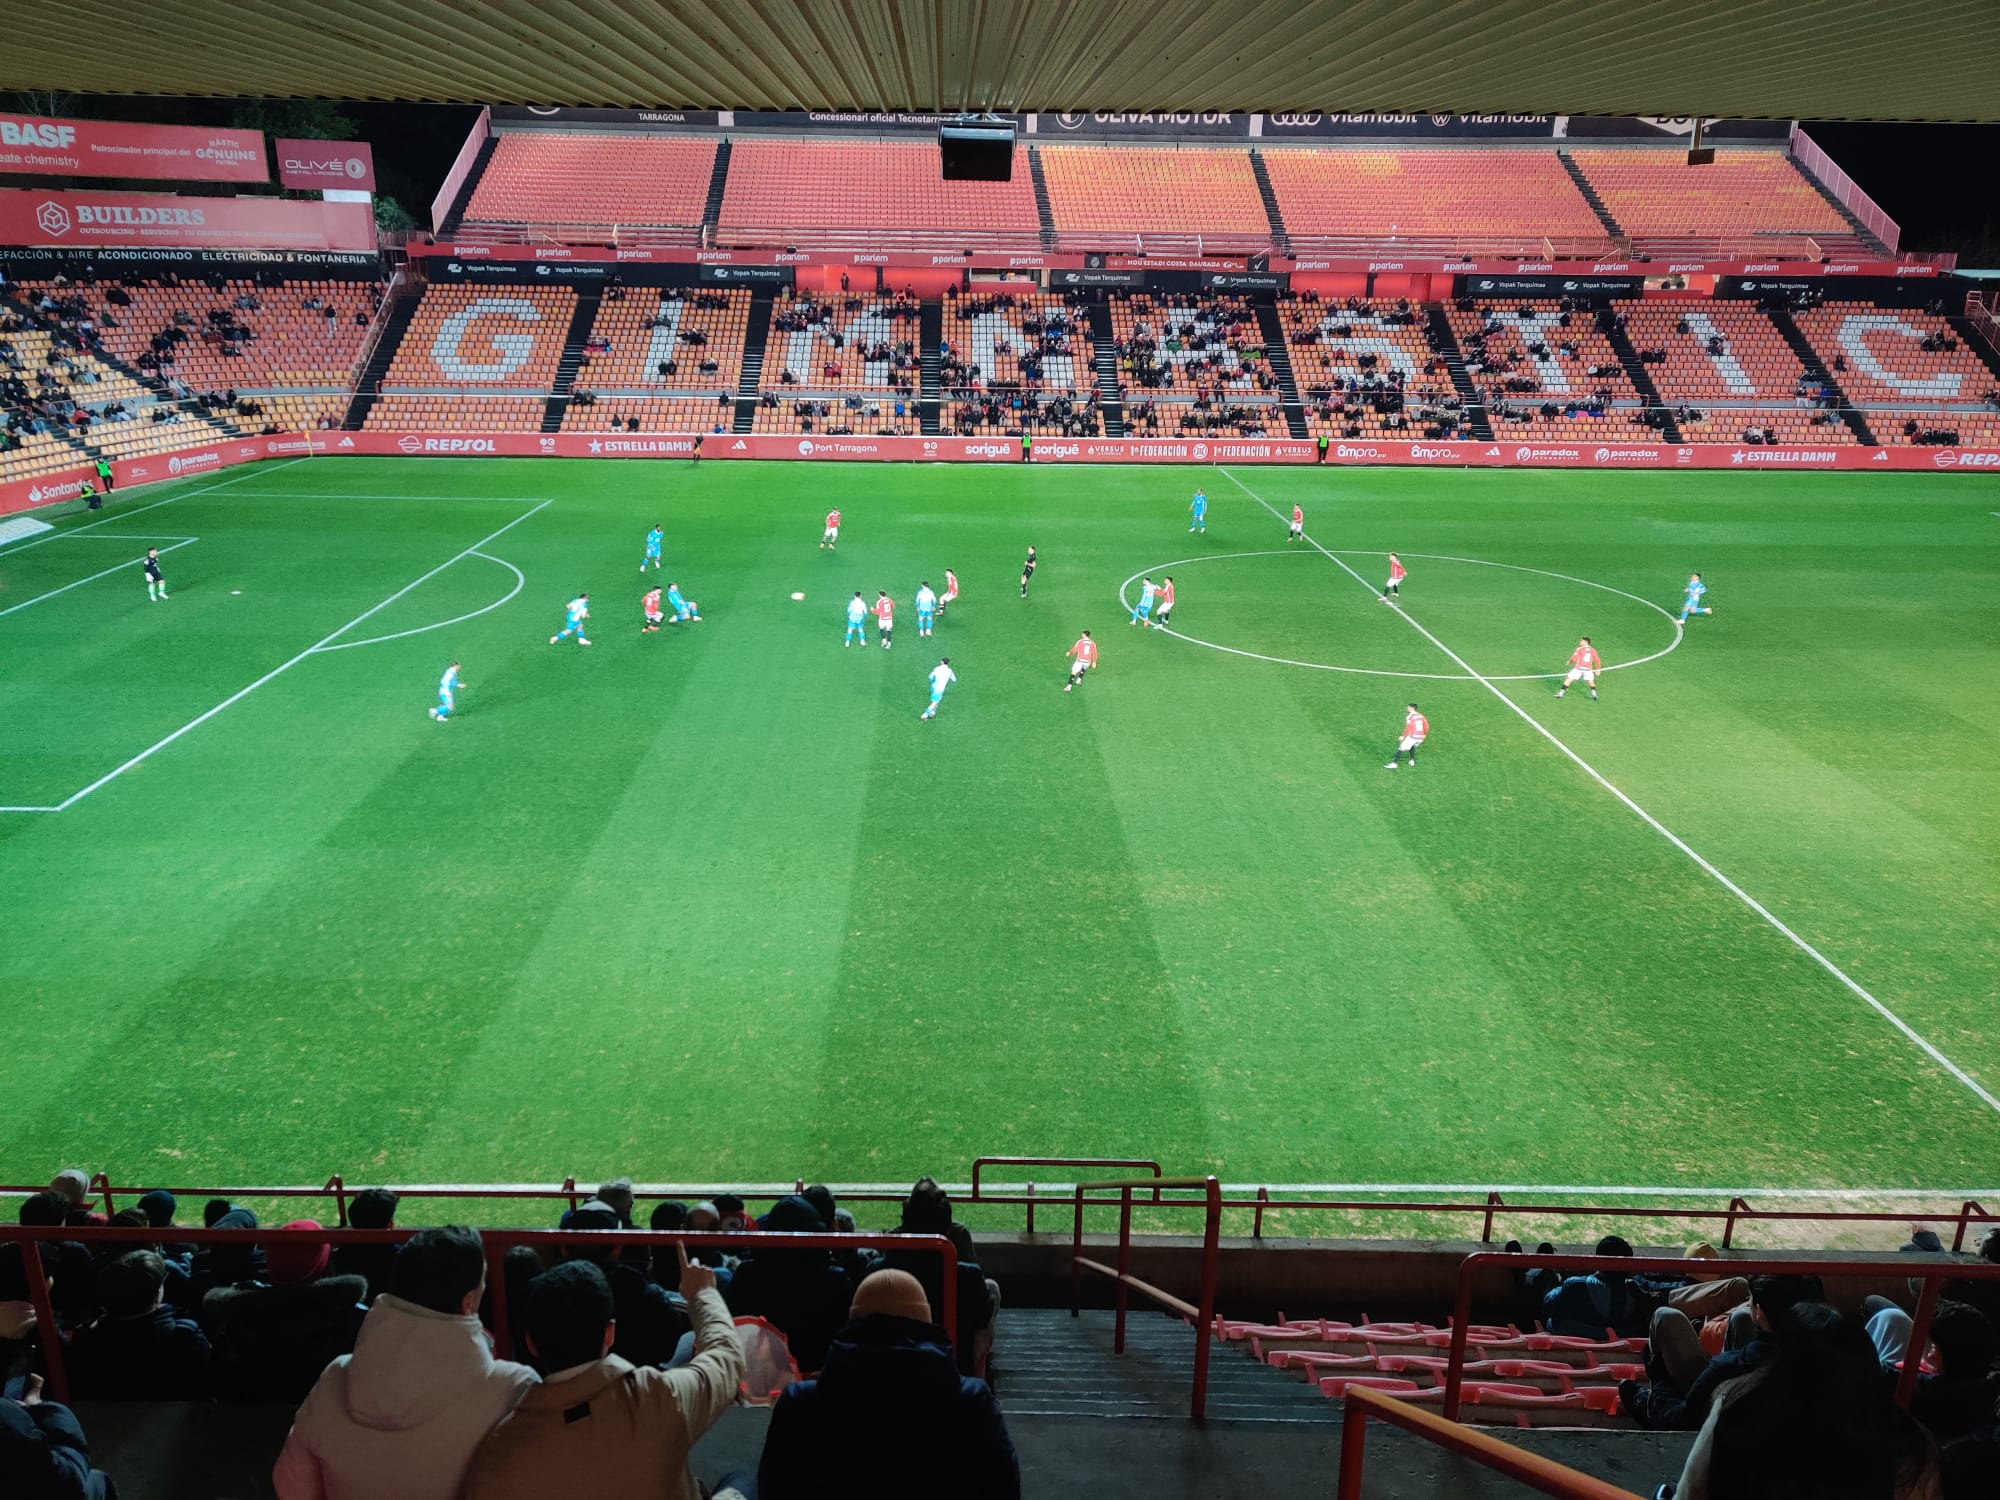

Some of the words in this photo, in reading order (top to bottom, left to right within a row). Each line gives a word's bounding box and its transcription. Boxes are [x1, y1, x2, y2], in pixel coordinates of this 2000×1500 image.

[638, 113, 686, 122] TARRAGONA
[809, 112, 868, 122] Concessionari
[870, 113, 896, 122] oficial
[0, 122, 76, 148] BASF
[91, 144, 141, 154] Patrocinador
[143, 147, 177, 156] principal
[24, 154, 79, 169] chemistry
[285, 158, 344, 170] OLIVÉ
[75, 206, 205, 225] BUILDERS
[57, 251, 64, 259] &
[68, 251, 94, 260] AIRE
[98, 251, 193, 260] ACONDICIONADO
[202, 252, 283, 262] ELECTRICIDAD
[287, 253, 294, 262] &
[298, 253, 367, 264] FONTANERIA
[425, 438, 496, 451] REPSOL
[604, 441, 656, 452] ESTRELLA
[658, 441, 692, 452] DAMM
[815, 443, 833, 452] Port
[834, 443, 878, 454] Tarragona
[1282, 446, 1312, 454] VERSUS
[1140, 444, 1187, 457] FEDERACIÓN
[1222, 444, 1270, 457] FEDERACIÓN
[1532, 449, 1579, 457] paradox
[1611, 449, 1658, 458] paradox
[1747, 451, 1800, 461] ESTRELLA
[1801, 452, 1837, 462] DAMM
